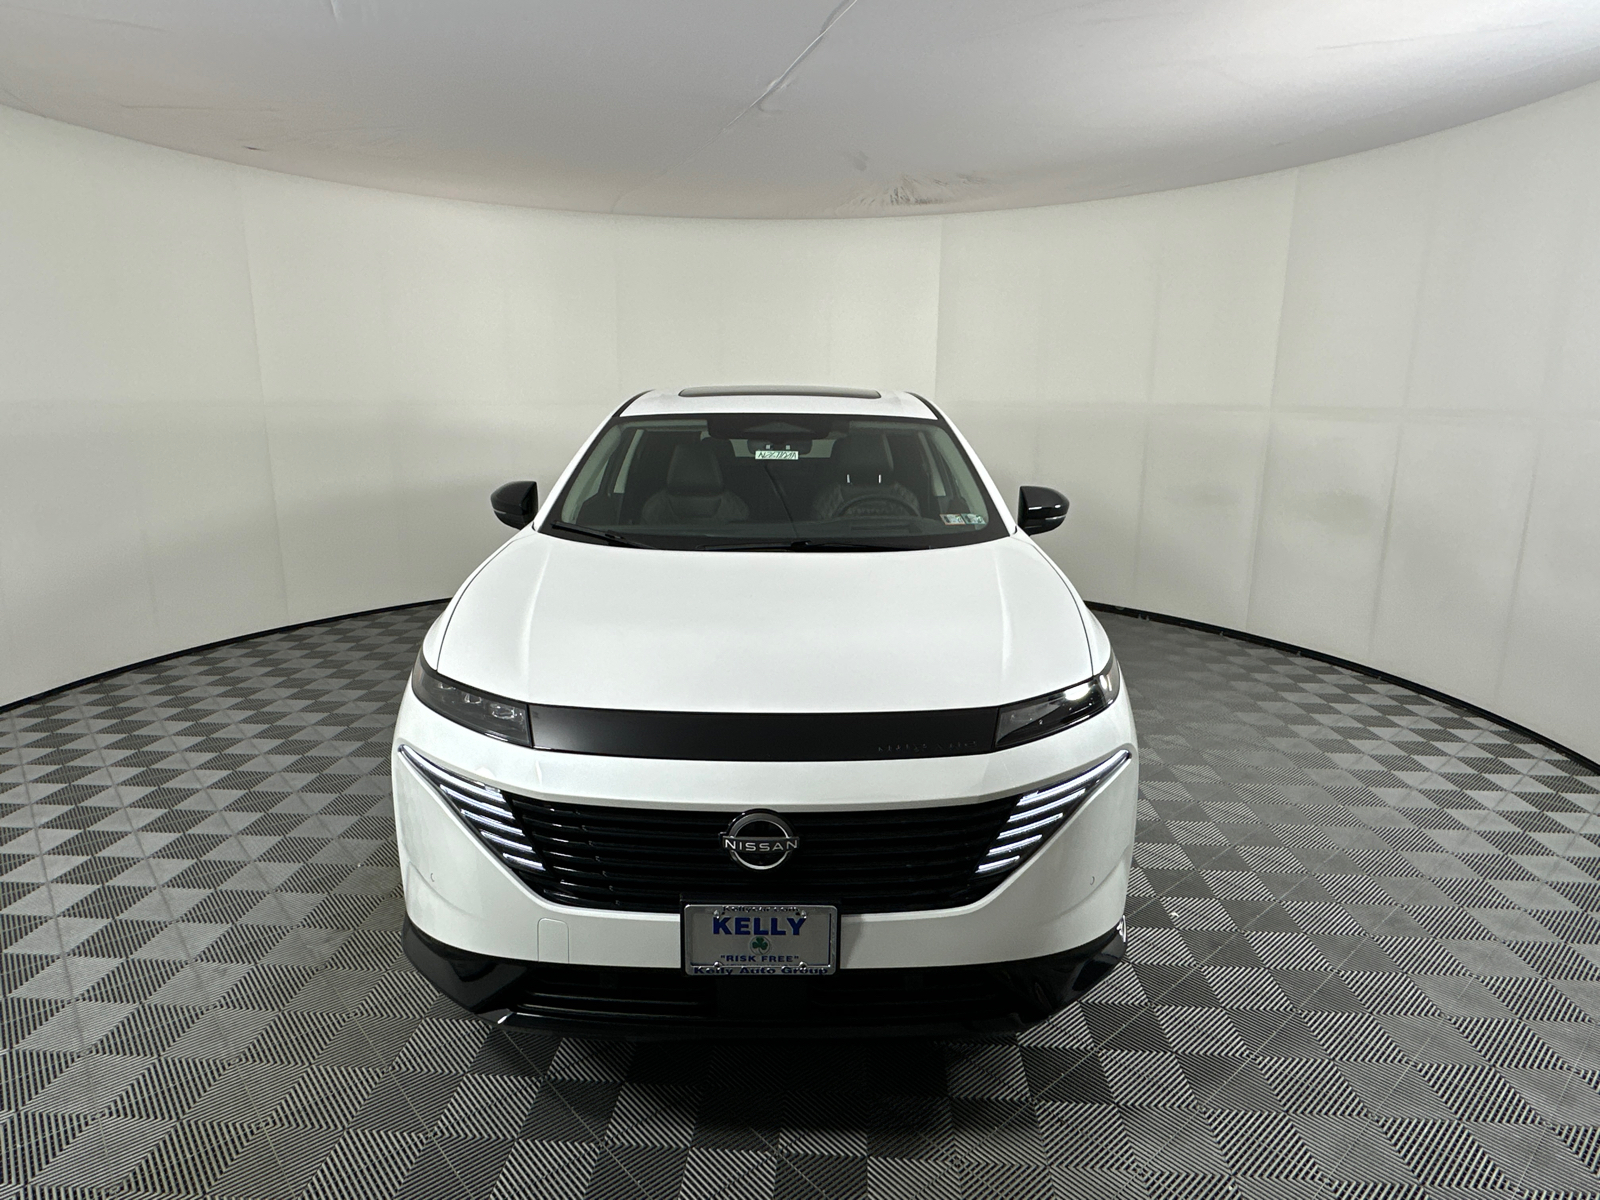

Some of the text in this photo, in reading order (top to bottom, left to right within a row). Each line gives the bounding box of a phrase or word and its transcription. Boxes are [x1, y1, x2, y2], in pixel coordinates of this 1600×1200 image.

[724, 839, 797, 851] NISSAN
[713, 917, 807, 935] KELLY
[761, 955, 799, 963] FREE"
[694, 967, 733, 975] Kelly
[781, 967, 828, 975] Group
